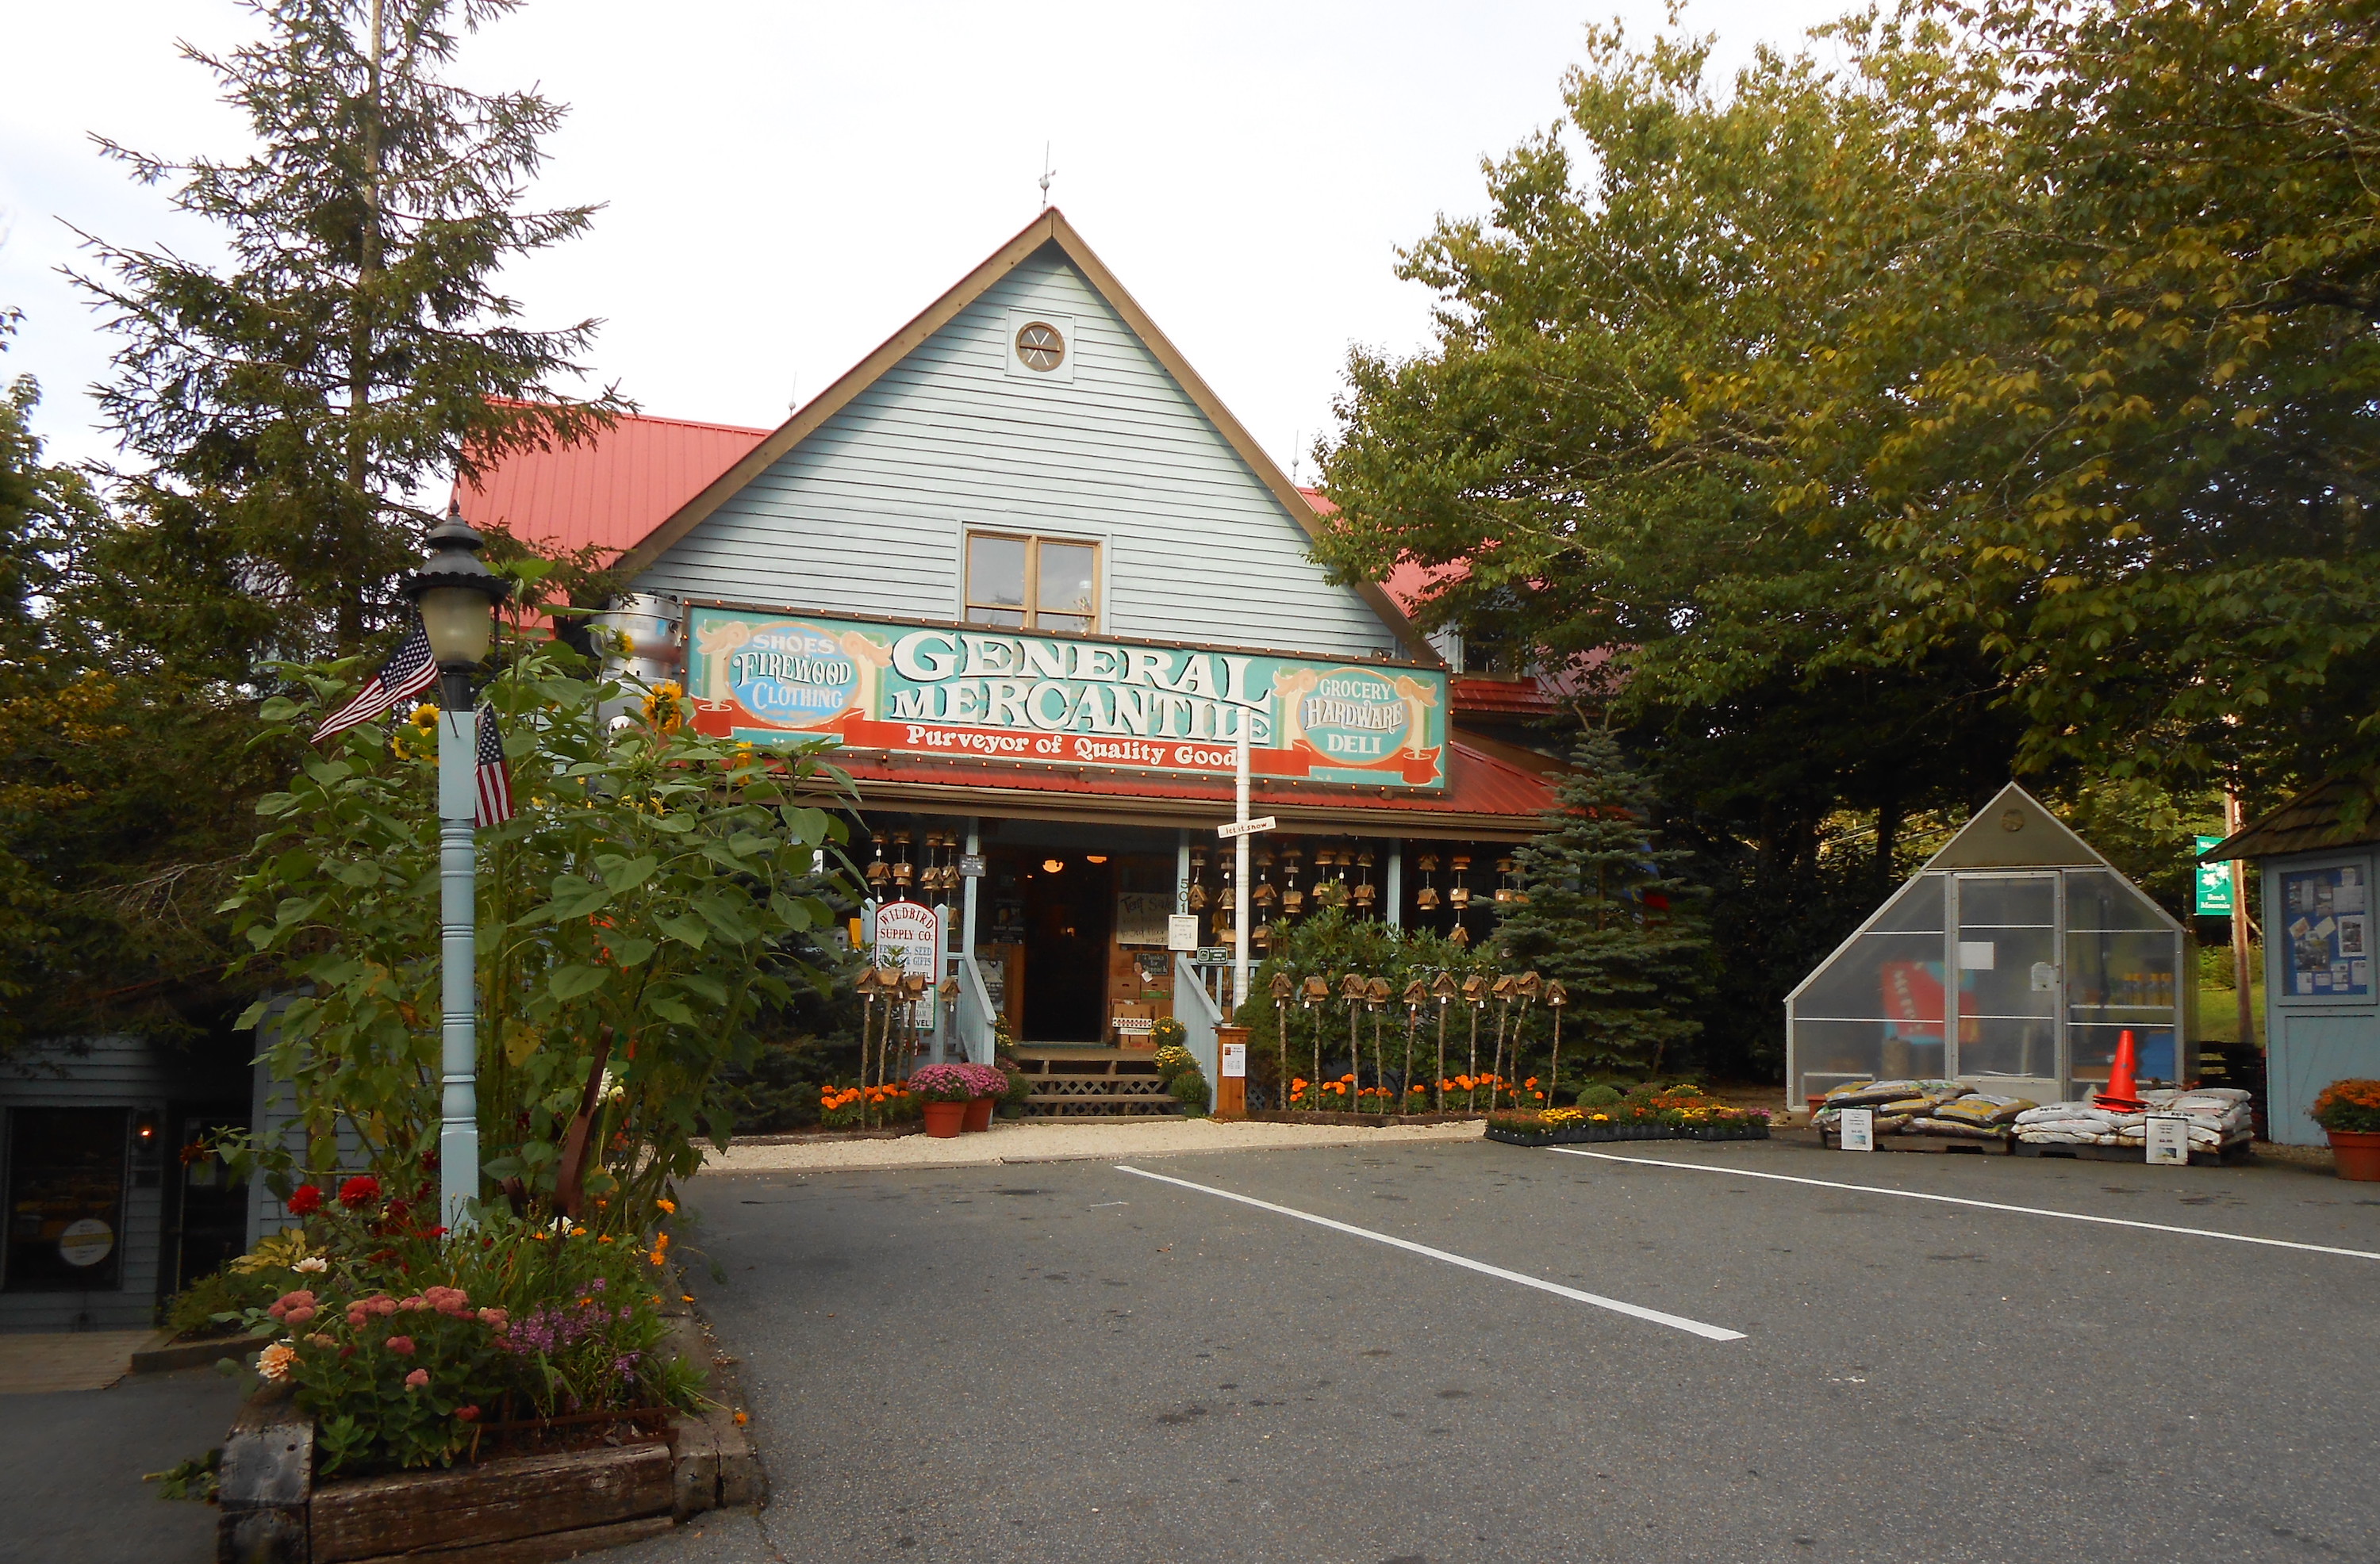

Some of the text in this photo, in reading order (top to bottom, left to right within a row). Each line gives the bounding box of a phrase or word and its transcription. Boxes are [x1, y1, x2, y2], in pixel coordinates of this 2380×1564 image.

[753, 634, 835, 654] SHOES
[733, 652, 852, 688] FIREWOOD
[892, 631, 1271, 714] GENERAL
[753, 682, 843, 710] CLOTHING
[1319, 678, 1391, 700] GROCERY
[890, 680, 1270, 744] MERCANTILE
[1305, 697, 1403, 734] HARDWARE
[906, 725, 1238, 767] Purveyor of Quality Good
[1326, 734, 1381, 754] DELI
[1246, 822, 1267, 831] snow
[1180, 878, 1188, 913] 501
[880, 907, 934, 929] WILDBIRD
[880, 928, 933, 941] SUPPLY CO.
[913, 956, 931, 966] GIFTS
[915, 946, 932, 956] SEED
